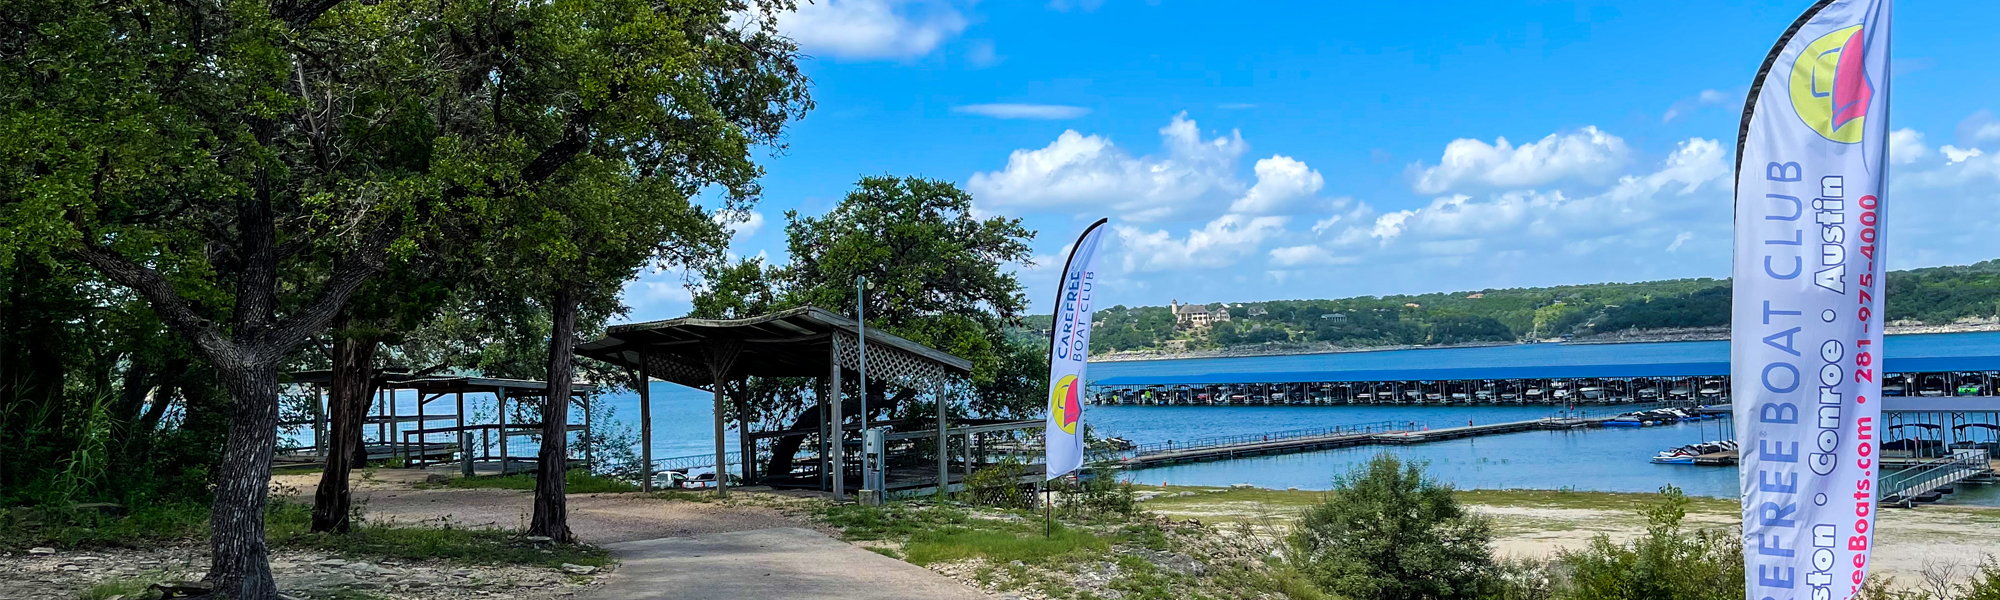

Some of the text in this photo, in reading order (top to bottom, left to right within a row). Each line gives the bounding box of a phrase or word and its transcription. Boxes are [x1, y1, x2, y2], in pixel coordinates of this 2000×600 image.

[1811, 175, 1845, 294] Austin
[1855, 194, 1877, 383] 281-975-4000
[1058, 271, 1080, 359] CAREFREE
[1072, 271, 1094, 362] BOAT CLUB
[1759, 161, 1802, 600] EFREE BOAT CLUB
[1808, 339, 1844, 476] Conroe
